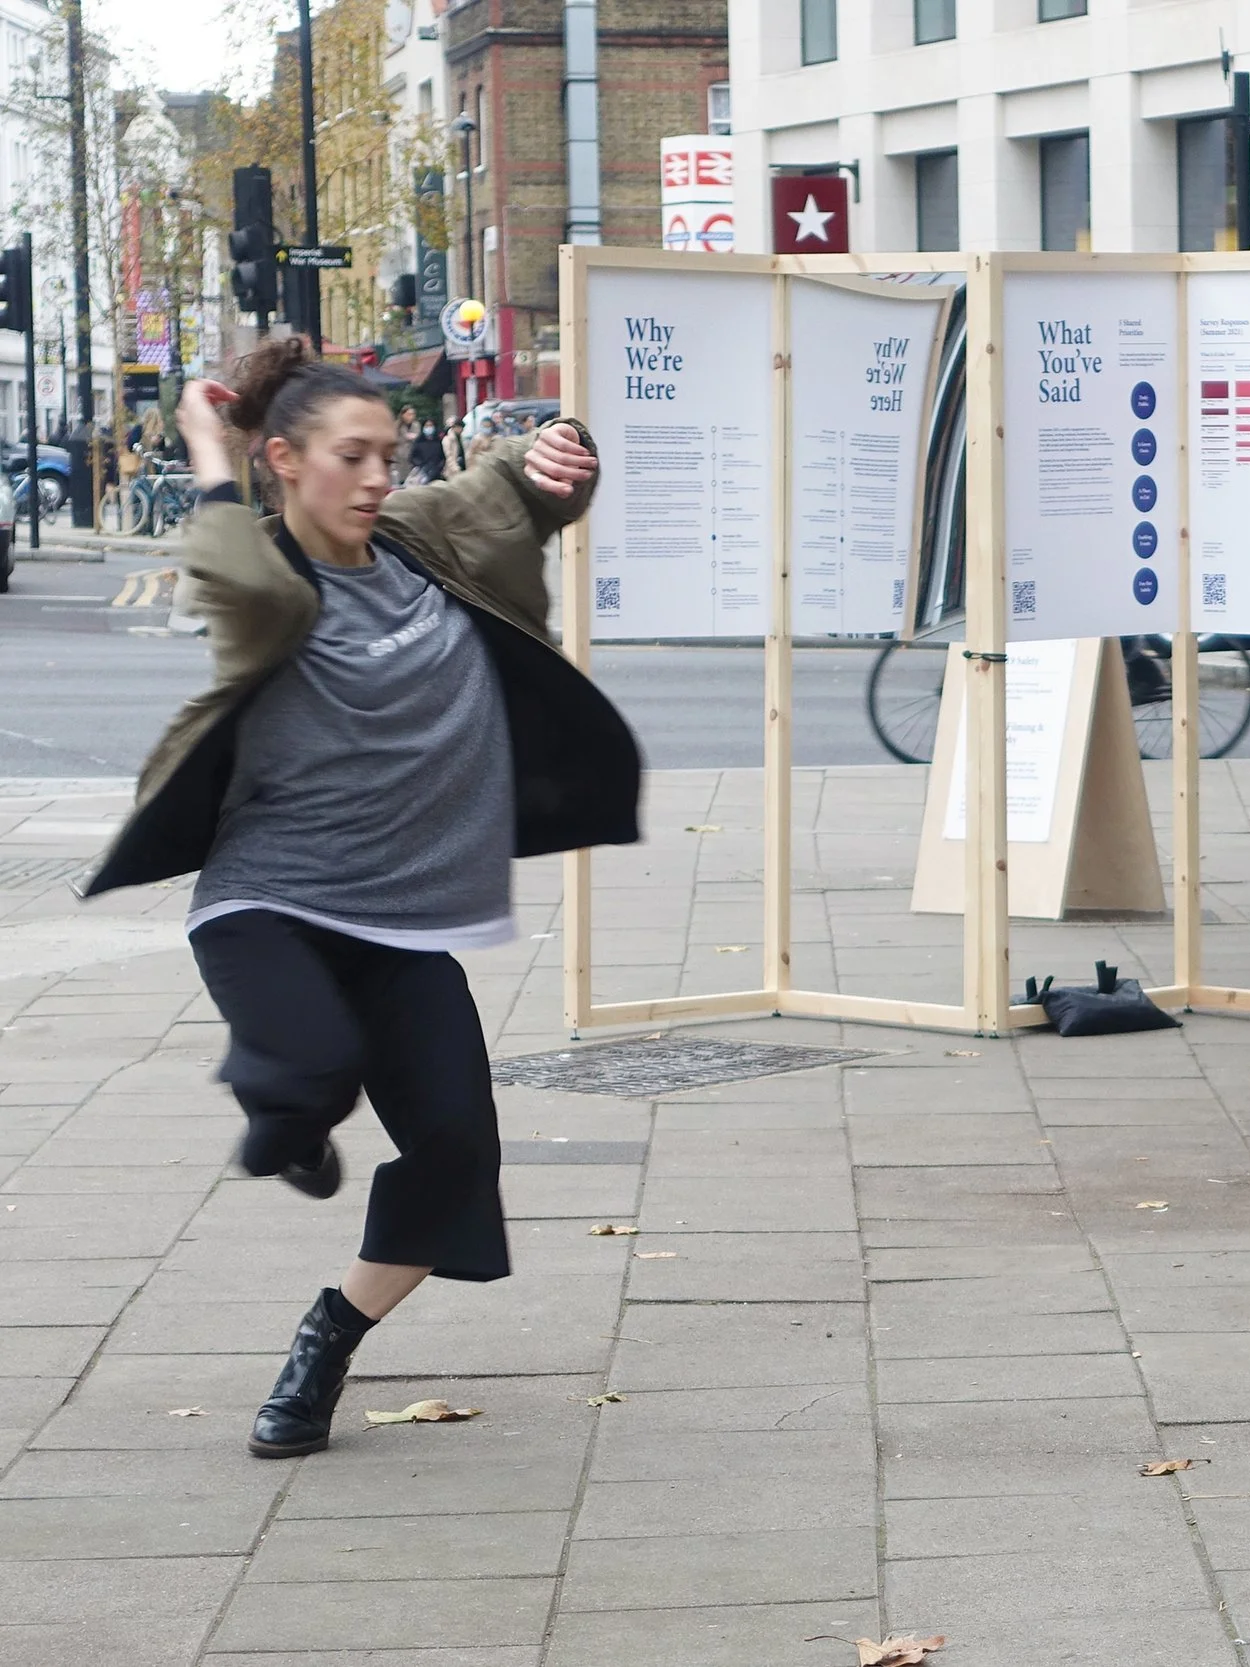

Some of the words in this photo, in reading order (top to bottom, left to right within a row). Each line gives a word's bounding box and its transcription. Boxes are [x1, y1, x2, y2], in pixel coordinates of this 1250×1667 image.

[289, 248, 322, 257] Imperial
[289, 257, 306, 265] War
[307, 257, 343, 266] Museum
[625, 317, 675, 348] Why
[1037, 320, 1092, 345] What
[1199, 319, 1219, 328] Survey
[1220, 318, 1250, 328] Responses
[625, 346, 683, 372] We're
[1038, 348, 1102, 375] You've
[625, 376, 676, 401] Here
[1038, 377, 1082, 403] Said
